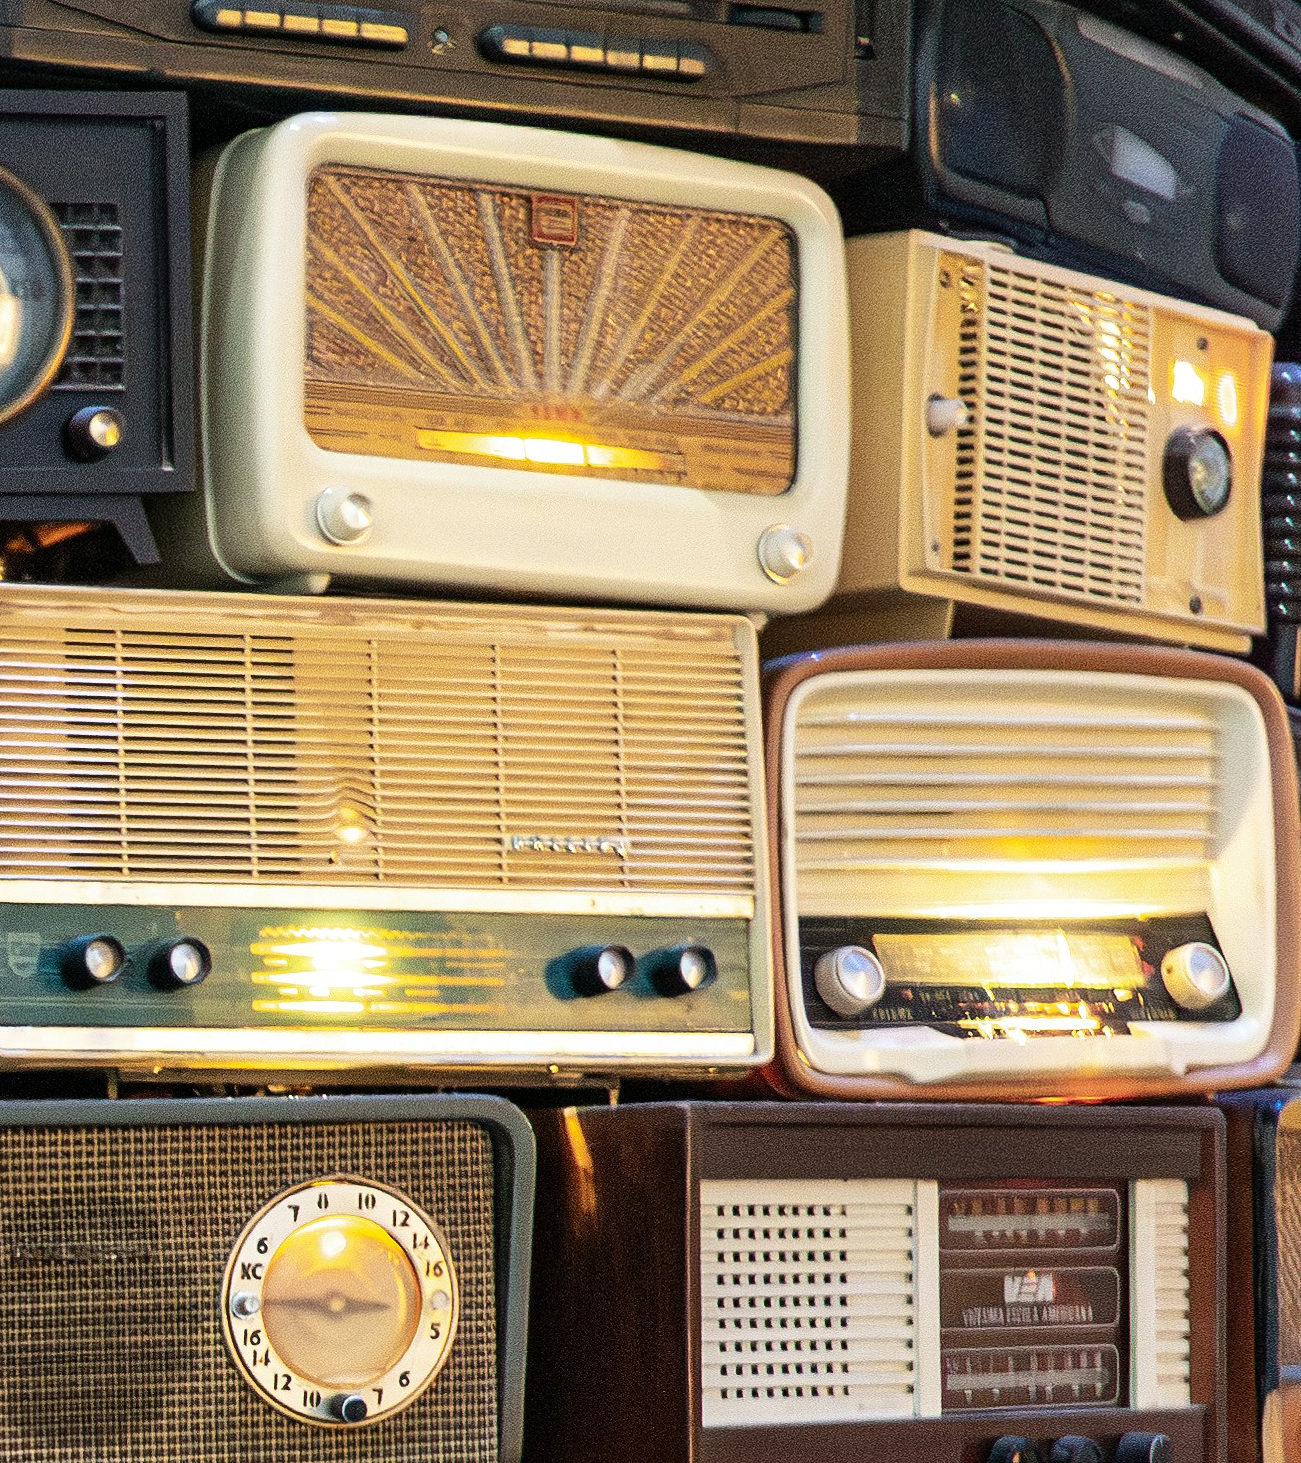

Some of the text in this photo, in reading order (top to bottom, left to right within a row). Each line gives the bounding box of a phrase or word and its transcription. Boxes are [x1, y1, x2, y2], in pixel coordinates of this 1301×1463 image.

[317, 1192, 329, 1210] 8
[358, 1193, 376, 1210] 10
[288, 1205, 300, 1222] 7
[392, 1209, 410, 1227] 12
[256, 1237, 268, 1255] 6
[412, 1233, 430, 1251] 14
[425, 1260, 444, 1277] 16
[243, 1329, 261, 1346] 16
[429, 1322, 442, 1340] 5
[252, 1348, 271, 1367] 14
[273, 1373, 292, 1391] 12
[399, 1370, 411, 1388] 6
[302, 1390, 321, 1408] 10
[372, 1388, 384, 1406] 7
